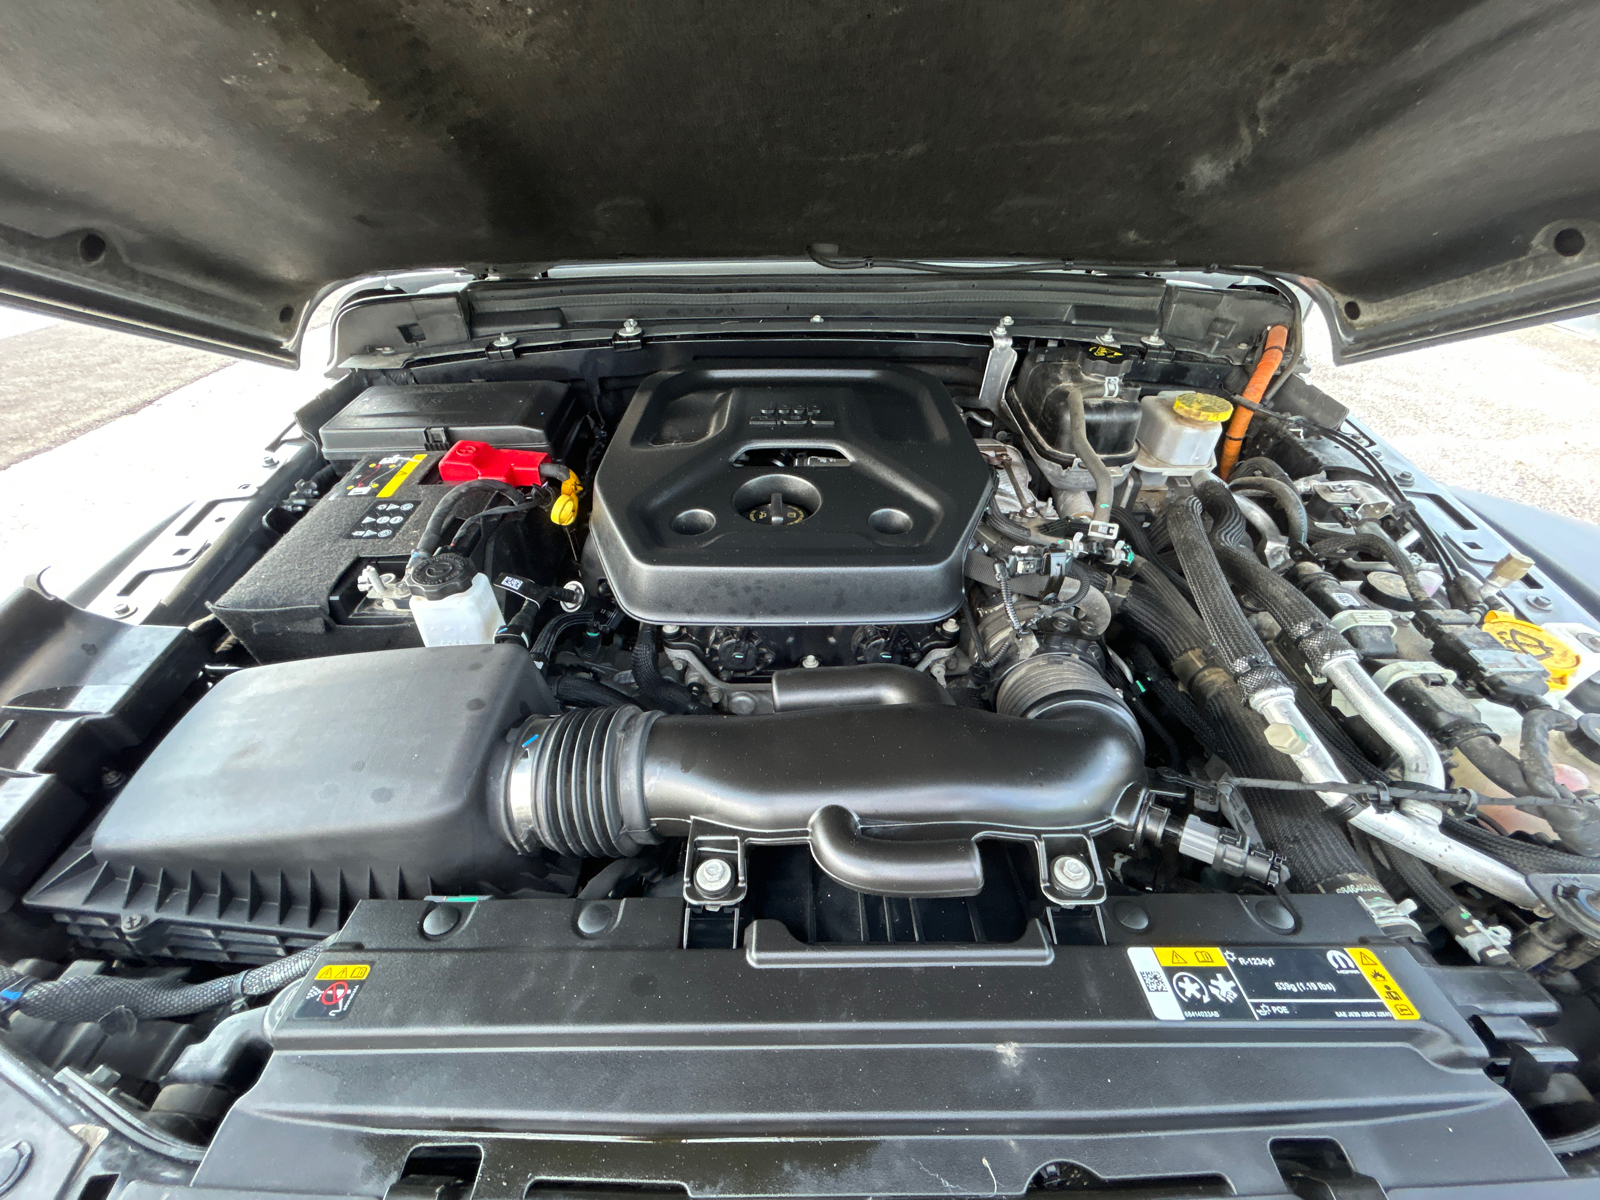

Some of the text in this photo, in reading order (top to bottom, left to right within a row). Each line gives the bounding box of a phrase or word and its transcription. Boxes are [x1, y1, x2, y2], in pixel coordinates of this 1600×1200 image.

[1238, 957, 1275, 967] R-1234yf
[1319, 982, 1337, 993] lbs)
[1271, 1006, 1290, 1014] POE
